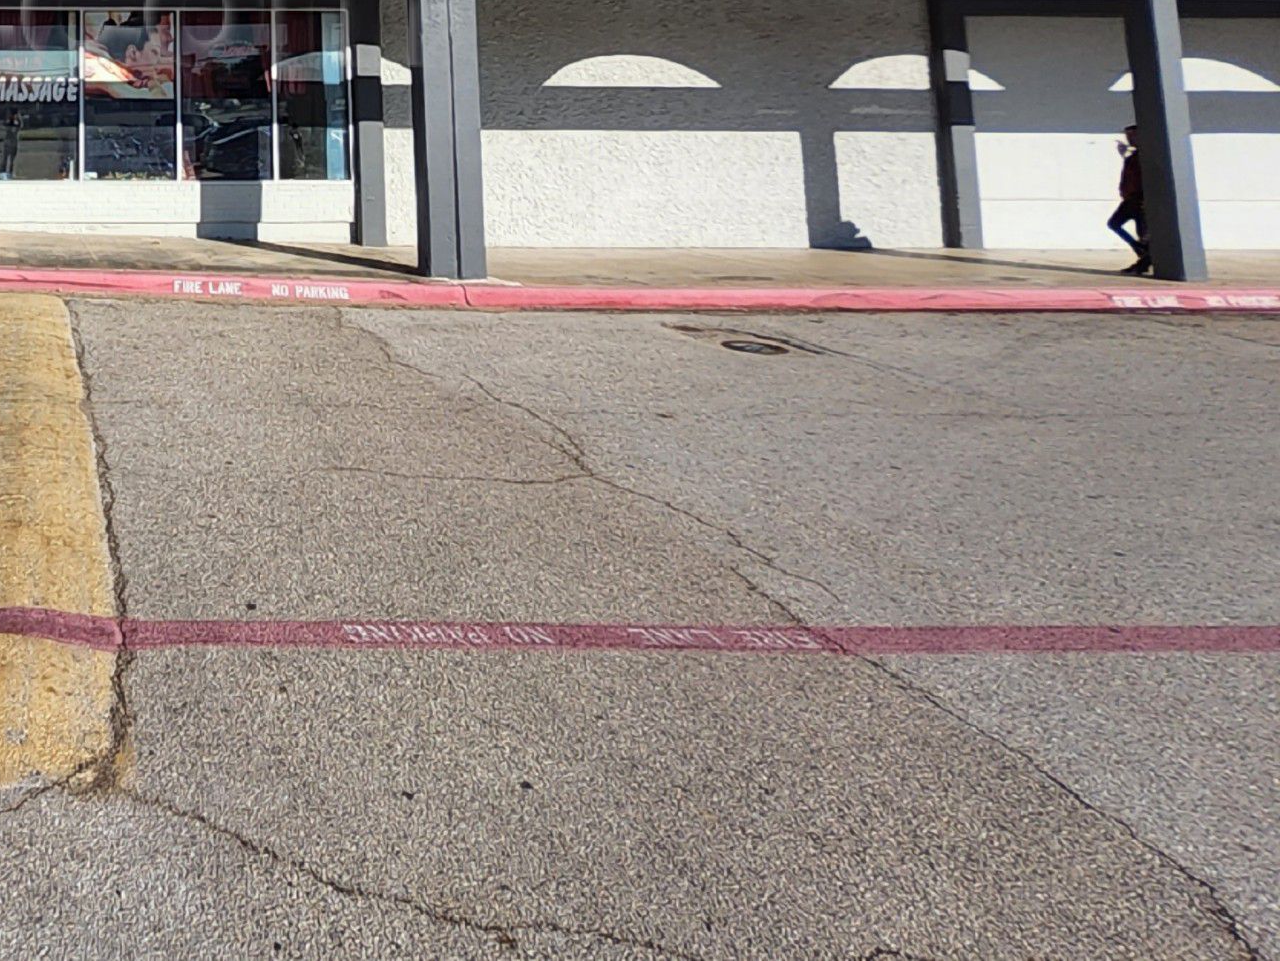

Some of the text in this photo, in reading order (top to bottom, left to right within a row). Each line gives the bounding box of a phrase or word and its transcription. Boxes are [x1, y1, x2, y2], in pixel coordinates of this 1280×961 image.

[173, 279, 350, 300] FIRE LANE NO PARKING
